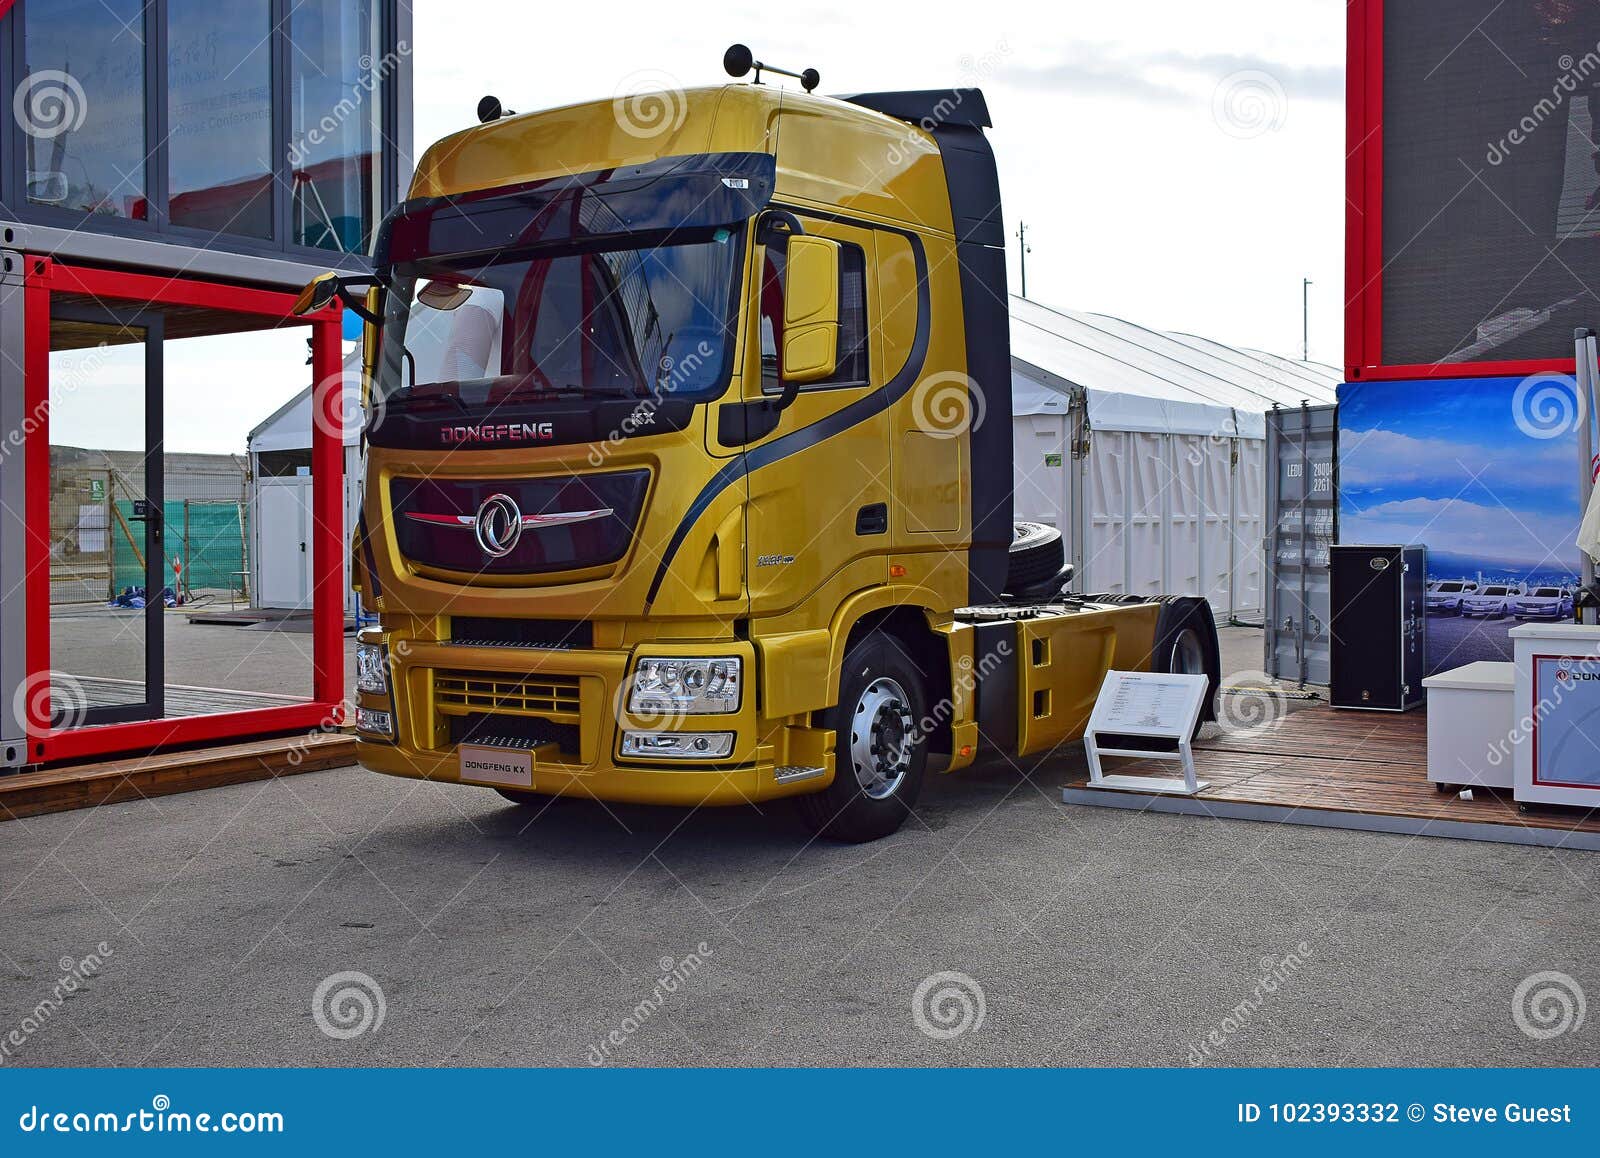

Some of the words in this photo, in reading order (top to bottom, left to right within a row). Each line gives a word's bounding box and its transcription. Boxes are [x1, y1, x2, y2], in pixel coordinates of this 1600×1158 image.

[441, 423, 553, 443] DONGFENG
[1287, 464, 1303, 477] LEDU
[465, 761, 511, 772] DONGFENG
[513, 766, 525, 774] KX
